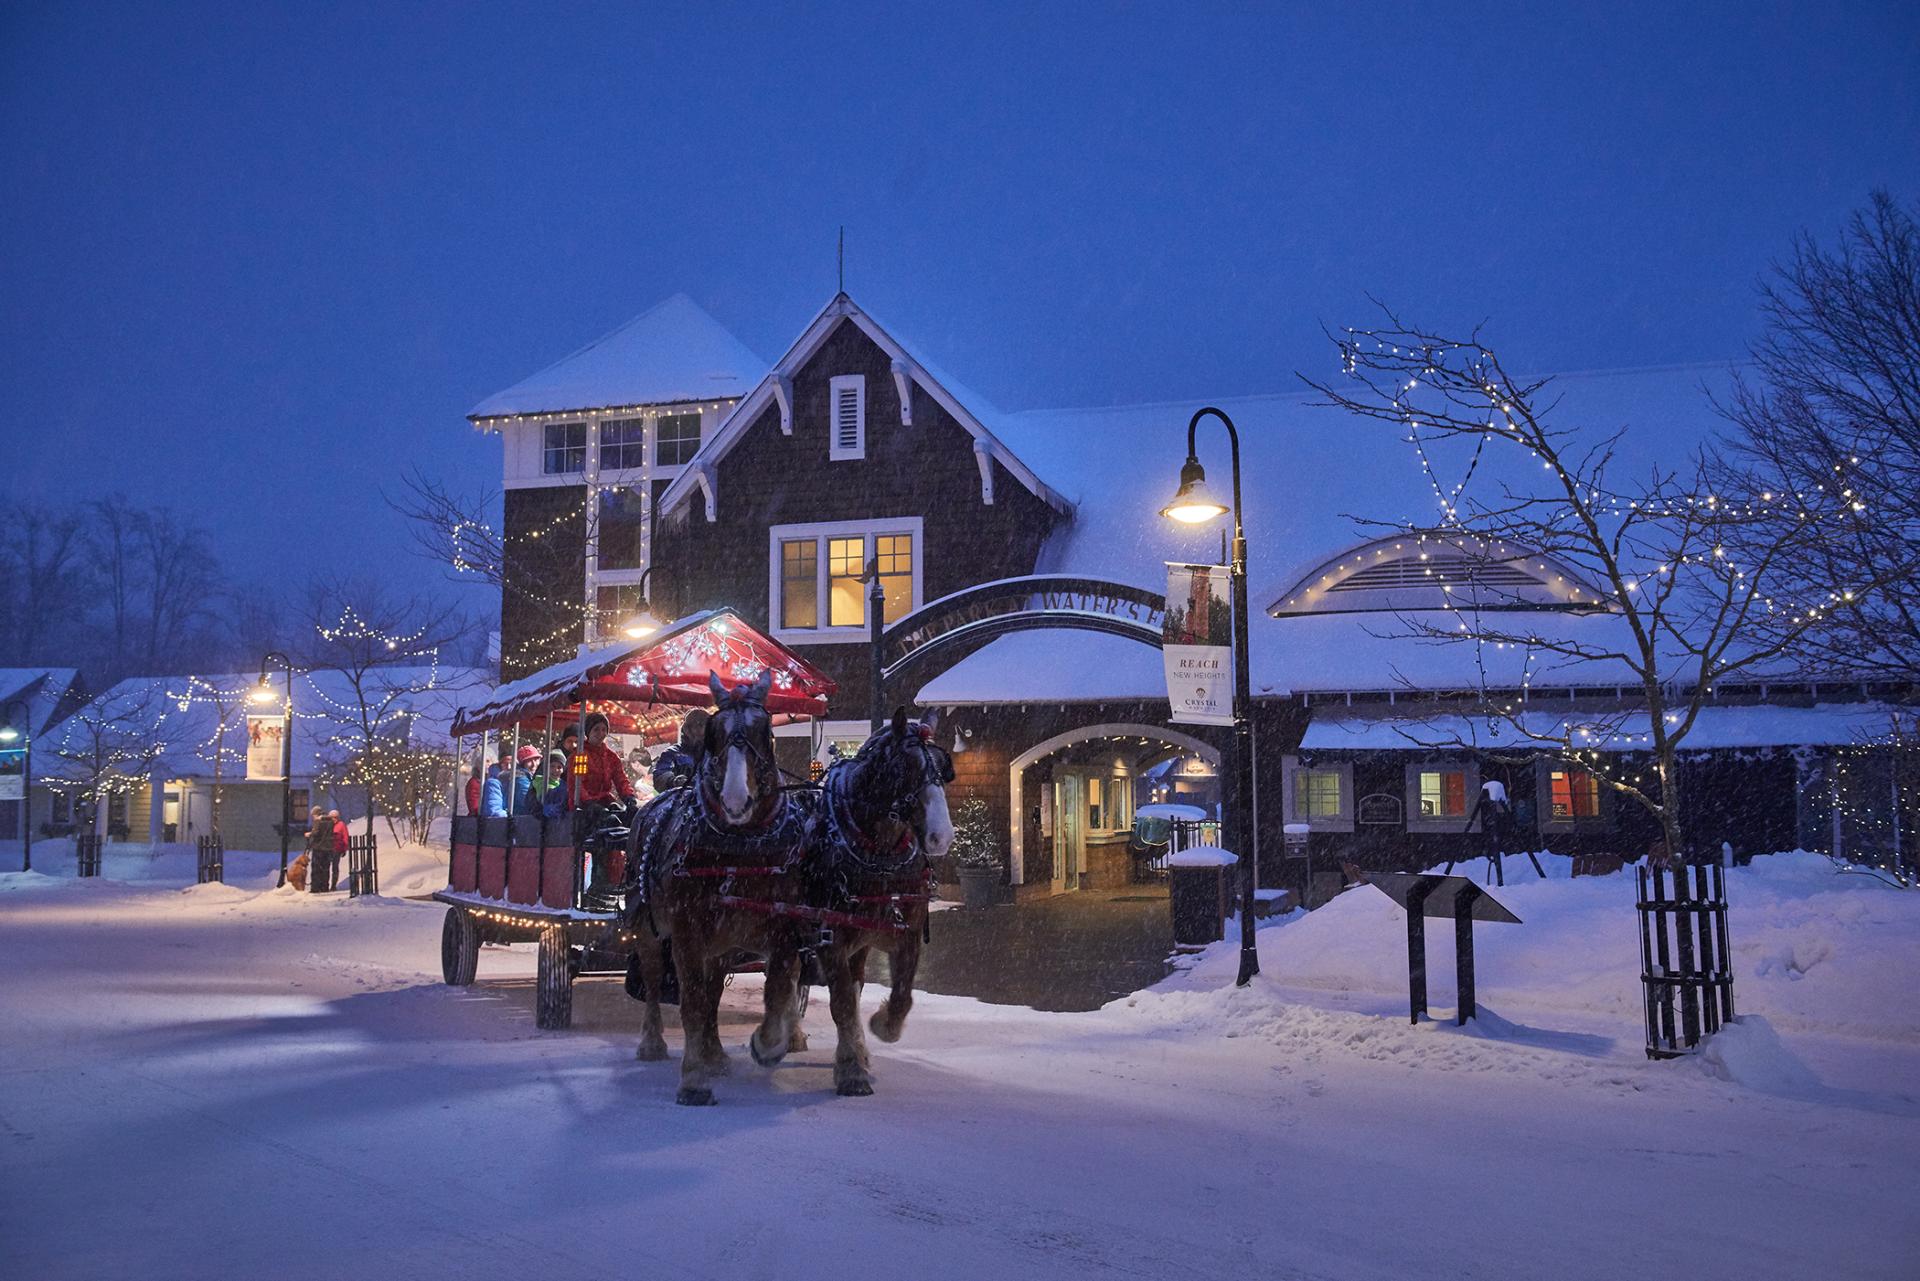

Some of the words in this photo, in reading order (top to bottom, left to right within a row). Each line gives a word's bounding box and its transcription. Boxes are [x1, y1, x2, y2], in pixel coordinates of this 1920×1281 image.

[1042, 591, 1140, 621] WATER'S
[1180, 659, 1219, 669] REACH
[1173, 671, 1190, 679] NEW
[1194, 672, 1226, 680] HEIGHTS
[1185, 699, 1217, 707] CRYSTAL
